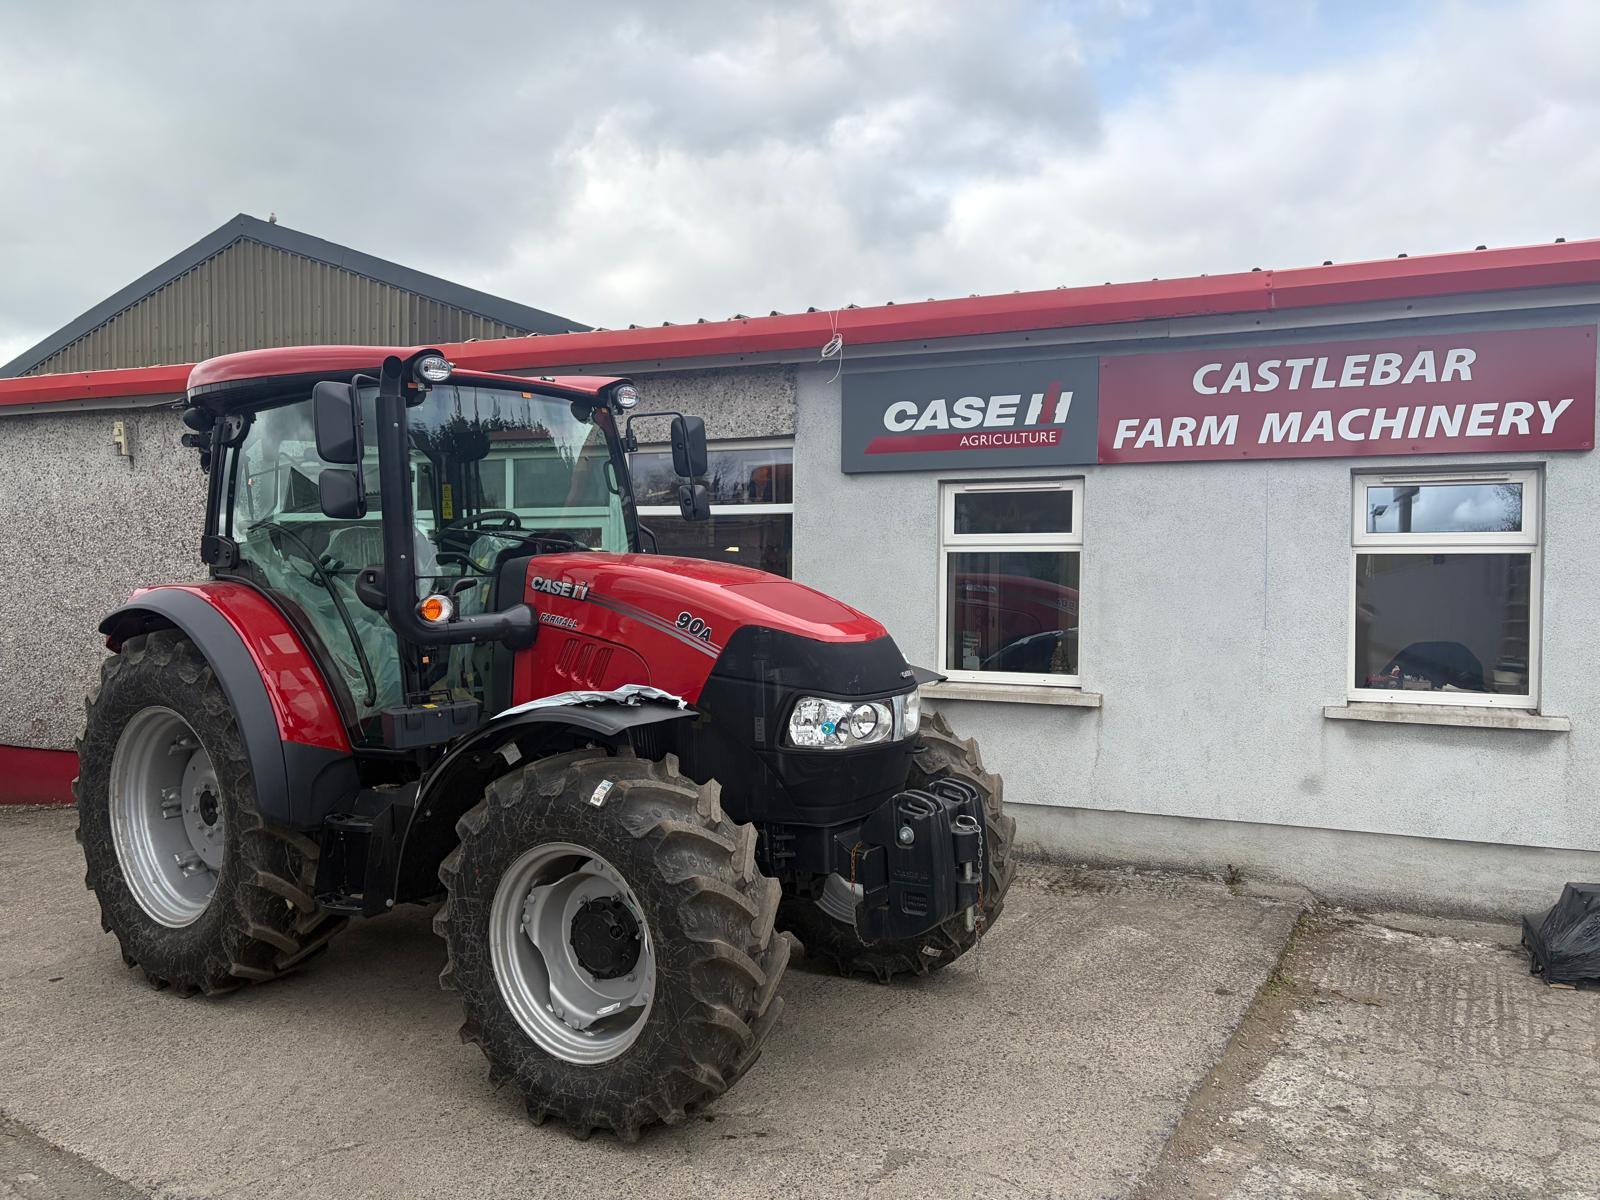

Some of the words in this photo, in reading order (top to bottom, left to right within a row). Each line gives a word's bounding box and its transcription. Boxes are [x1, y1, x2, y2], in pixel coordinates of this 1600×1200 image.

[1192, 348, 1477, 395] CASTLEBAR
[959, 431, 1057, 447] AGRICULTURE
[1112, 414, 1239, 450] FARM
[1257, 398, 1574, 445] MACHINERY
[539, 613, 578, 629] FARMALL
[675, 611, 712, 642] 90A
